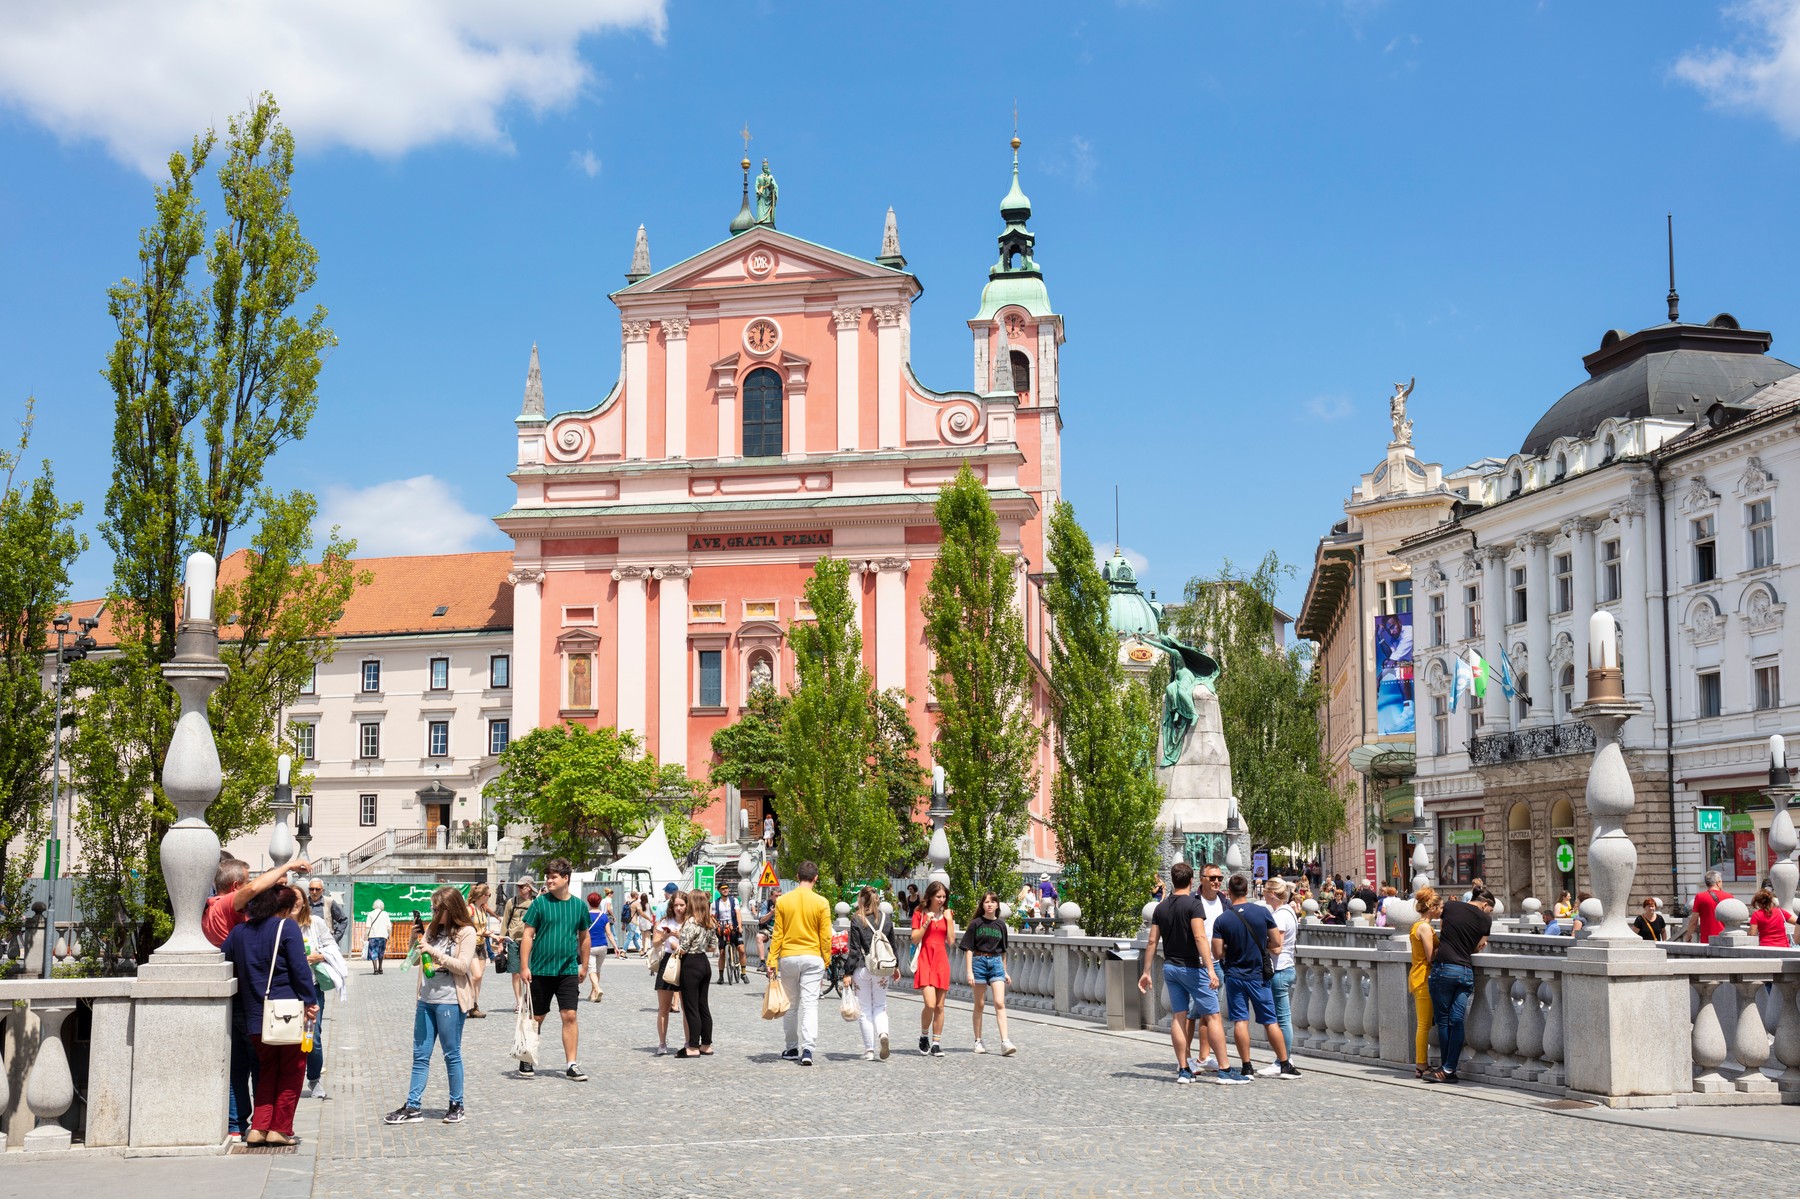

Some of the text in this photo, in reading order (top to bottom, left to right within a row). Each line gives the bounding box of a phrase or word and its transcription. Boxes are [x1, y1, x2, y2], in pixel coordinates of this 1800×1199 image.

[727, 535, 777, 548] GRATIA
[783, 533, 830, 546] PLENA!
[1510, 831, 1530, 839] APOTEKA
